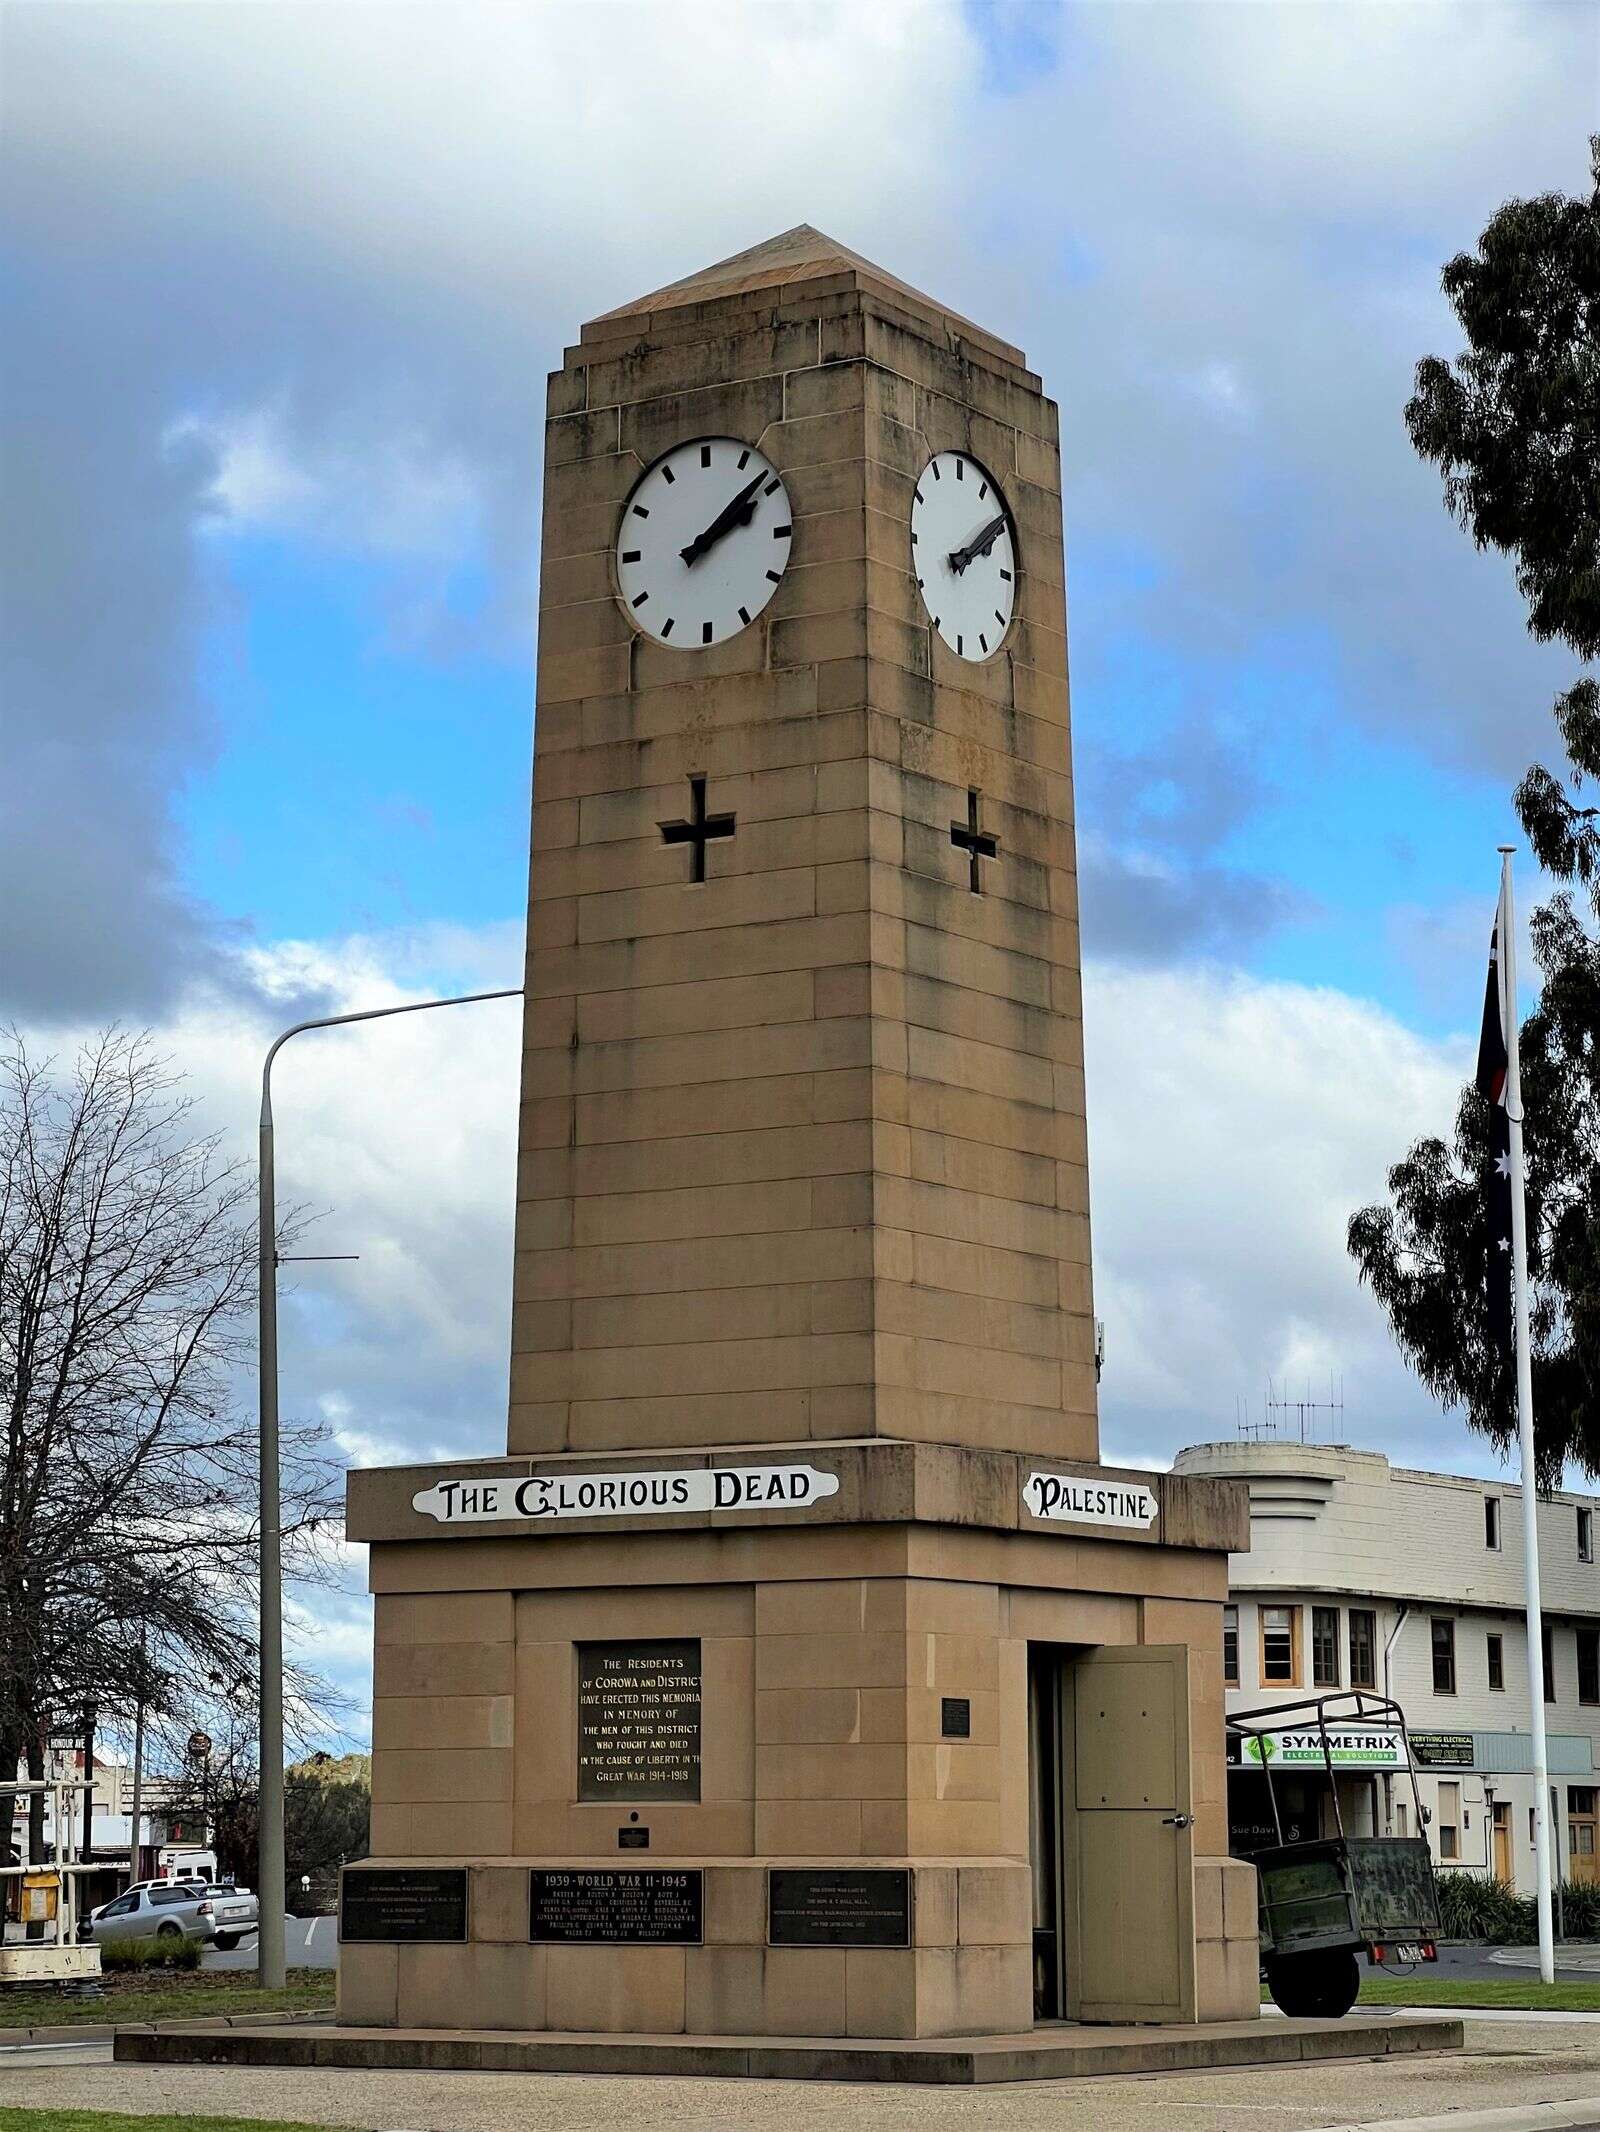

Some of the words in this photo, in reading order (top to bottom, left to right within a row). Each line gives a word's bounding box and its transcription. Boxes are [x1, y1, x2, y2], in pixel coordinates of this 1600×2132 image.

[438, 1481, 498, 1520] THE
[514, 1478, 689, 1516] GLORIOUS
[713, 1471, 810, 1508] DEAD
[1032, 1477, 1149, 1519] PALESTINE
[602, 1659, 621, 1670] THE
[628, 1658, 684, 1669] RESIDENTS
[582, 1680, 592, 1689] OF
[595, 1676, 639, 1689] COROWA
[640, 1679, 656, 1688] AND
[657, 1675, 701, 1688] DISTRIC
[580, 1695, 600, 1705] HAVE
[602, 1694, 639, 1704] ERECTED
[640, 1694, 660, 1703] THIS
[662, 1693, 701, 1703] MEMORIA
[603, 1710, 614, 1720] IN
[618, 1709, 661, 1720] MEMORY
[665, 1708, 679, 1719] OF
[583, 1726, 599, 1735] THE
[601, 1726, 618, 1735] MEN
[621, 1725, 633, 1735] OF
[634, 1725, 654, 1735] THIS
[657, 1724, 699, 1734] DISTRICT
[596, 1741, 613, 1750] WHO
[616, 1740, 647, 1749] FOUGHT
[650, 1740, 666, 1749] AND
[669, 1740, 688, 1749] DIED
[1282, 1735, 1398, 1749] SYMMETRIX
[580, 1756, 589, 1765] IN
[590, 1756, 605, 1765] THE
[606, 1755, 632, 1765] CAUSE
[634, 1755, 645, 1765] OF
[646, 1755, 680, 1764] LIBERTY
[682, 1754, 691, 1764] IN
[596, 1771, 625, 1781] GREAT
[626, 1771, 646, 1781] WAR
[1252, 1825, 1276, 1834] Davi
[618, 1875, 641, 1887] WAR
